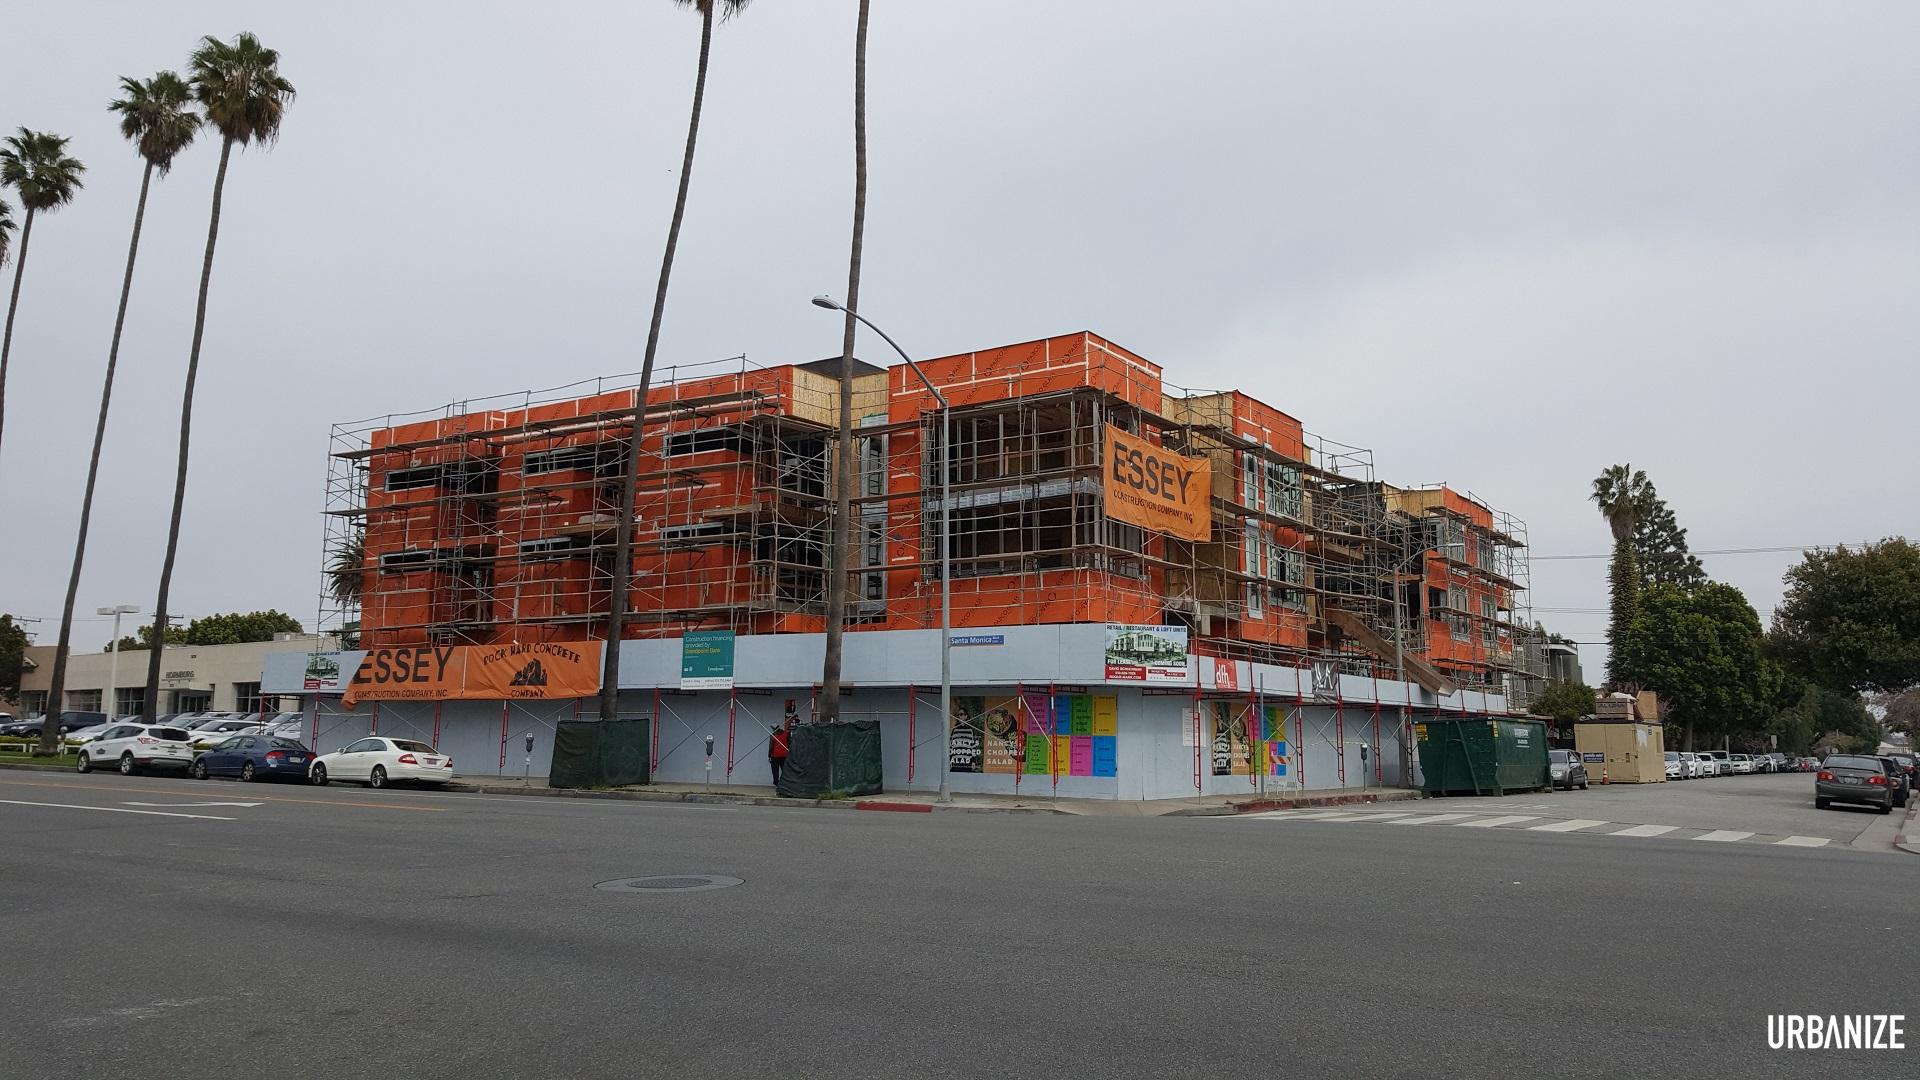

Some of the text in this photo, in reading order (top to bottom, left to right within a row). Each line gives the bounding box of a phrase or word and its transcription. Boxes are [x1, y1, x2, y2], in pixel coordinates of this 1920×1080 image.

[1113, 441, 1193, 505] ESSEY
[352, 647, 454, 684] ESSEY
[534, 642, 581, 664] CONCRETE
[511, 689, 544, 698] COMPANY
